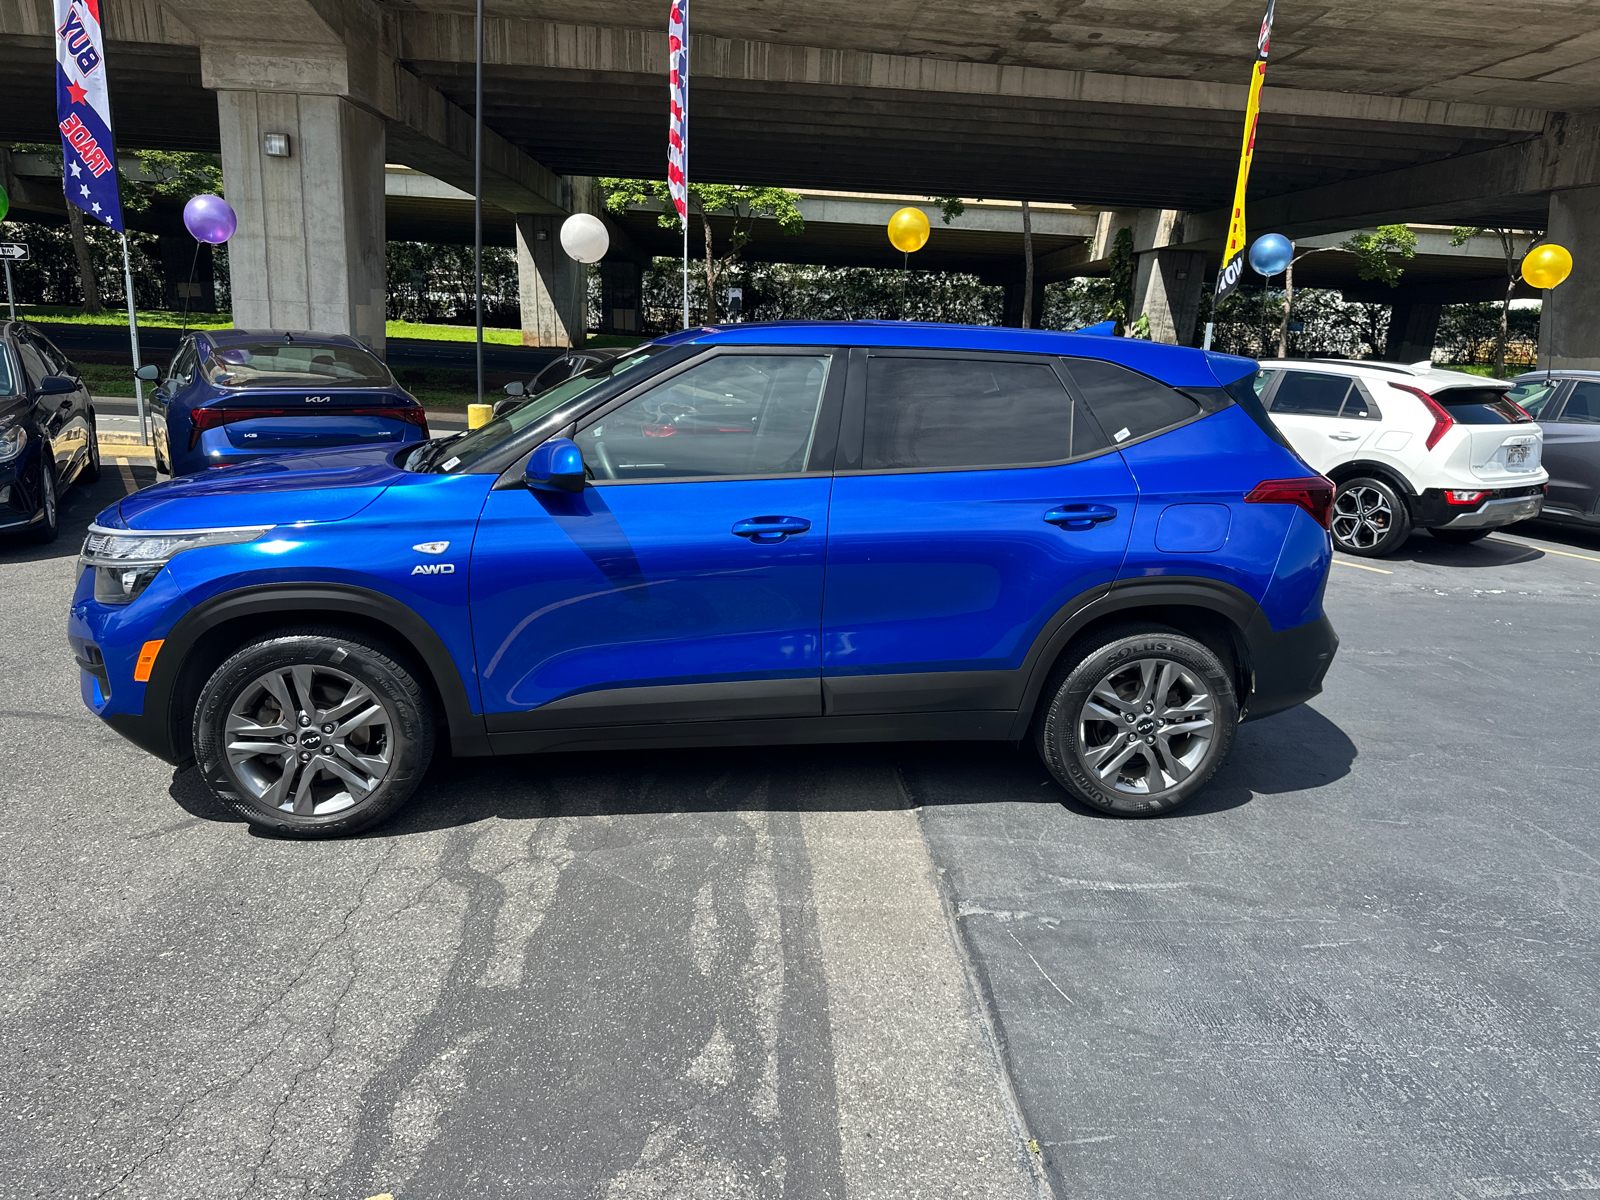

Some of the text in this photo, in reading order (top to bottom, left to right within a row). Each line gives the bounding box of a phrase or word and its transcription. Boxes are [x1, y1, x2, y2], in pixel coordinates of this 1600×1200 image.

[411, 564, 455, 576] AWD
[1107, 642, 1168, 663] SOLUS
[1070, 763, 1114, 808] KUMHO
